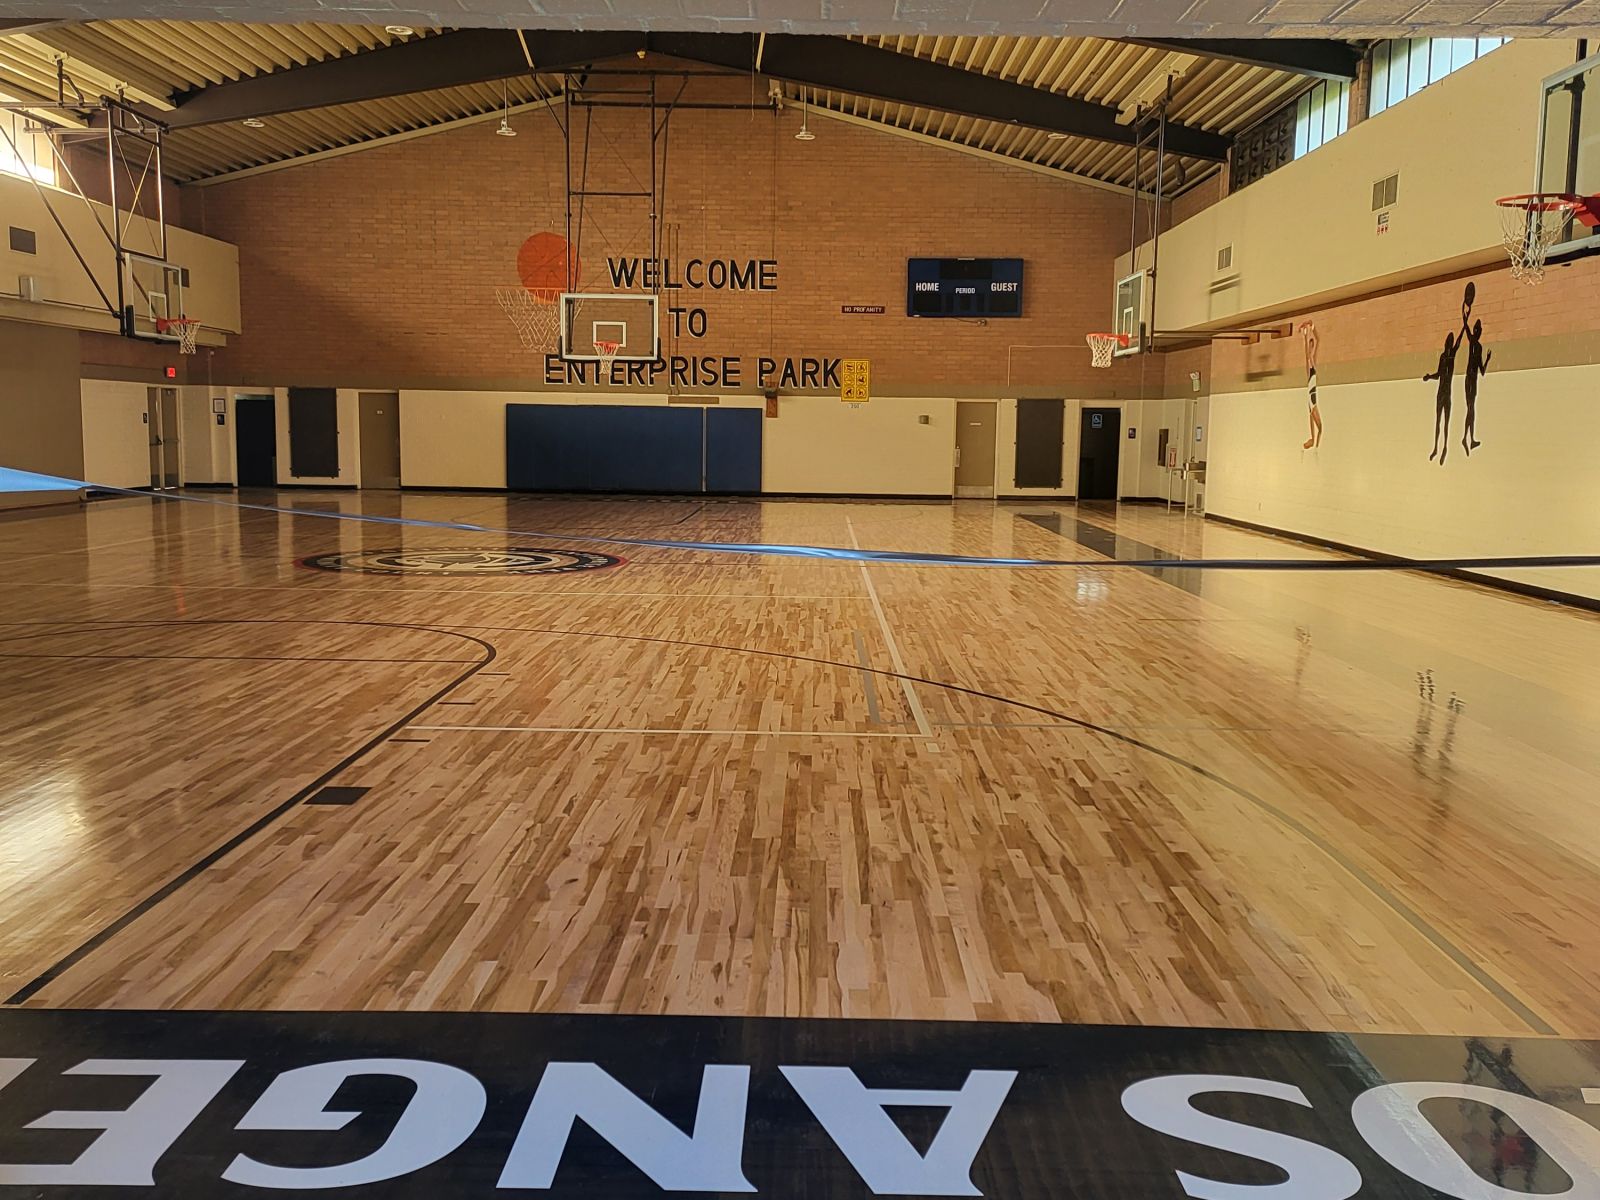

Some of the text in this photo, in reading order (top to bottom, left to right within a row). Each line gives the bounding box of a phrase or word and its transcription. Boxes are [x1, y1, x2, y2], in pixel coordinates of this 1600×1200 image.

[606, 257, 778, 292] WELCOME
[915, 282, 940, 292] HOME
[991, 282, 1018, 292] GUEST
[667, 307, 708, 339] TO
[543, 353, 842, 389] ENTERPRISE PARK
[0, 1057, 1600, 1200] OS ANGE
